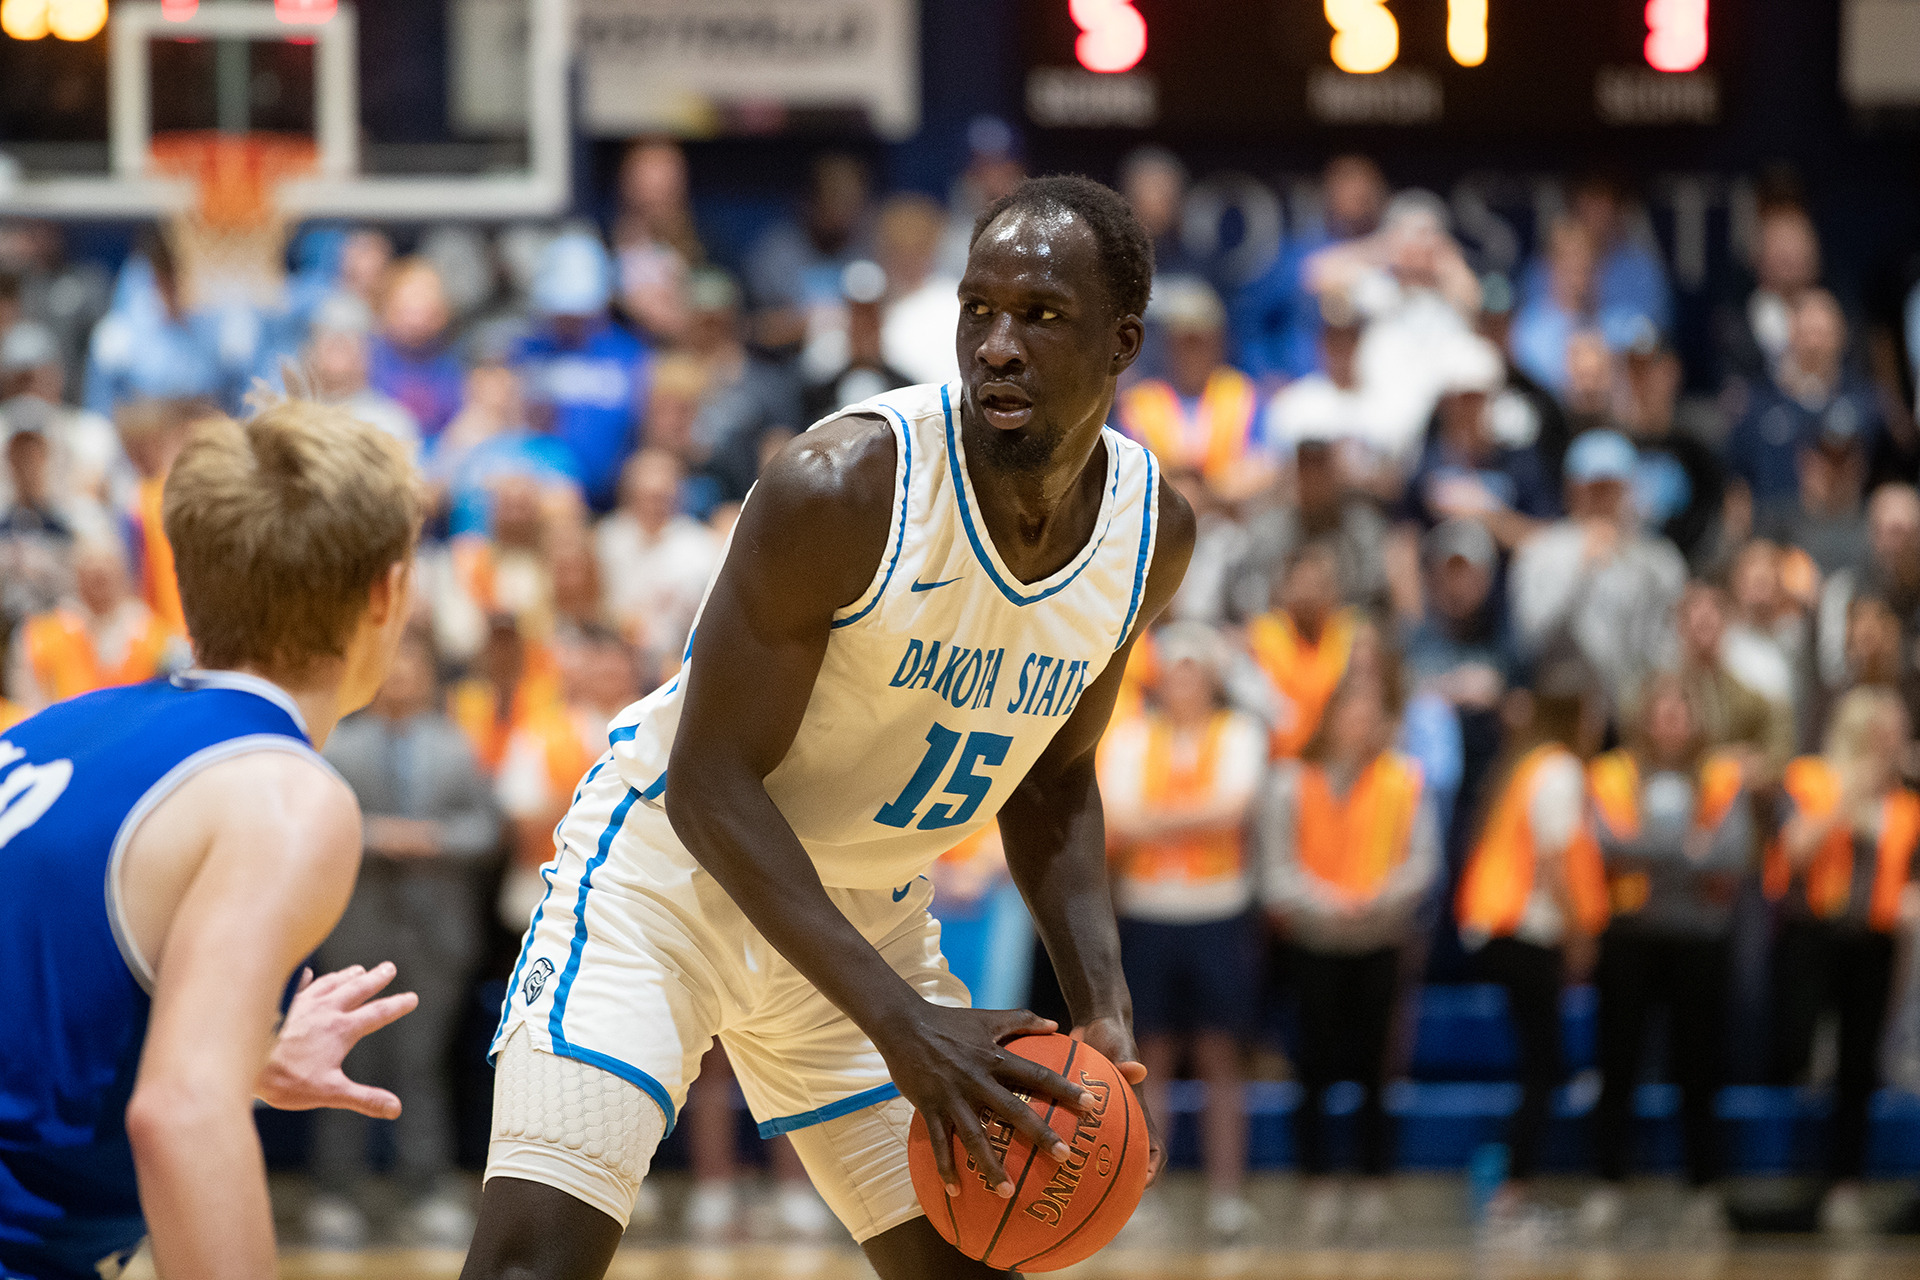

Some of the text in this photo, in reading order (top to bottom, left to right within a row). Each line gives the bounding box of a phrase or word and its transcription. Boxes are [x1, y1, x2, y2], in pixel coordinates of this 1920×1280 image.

[888, 638, 1090, 717] DAKOTA STATE
[873, 721, 1014, 830] 15
[1023, 1069, 1111, 1228] SPALDING
